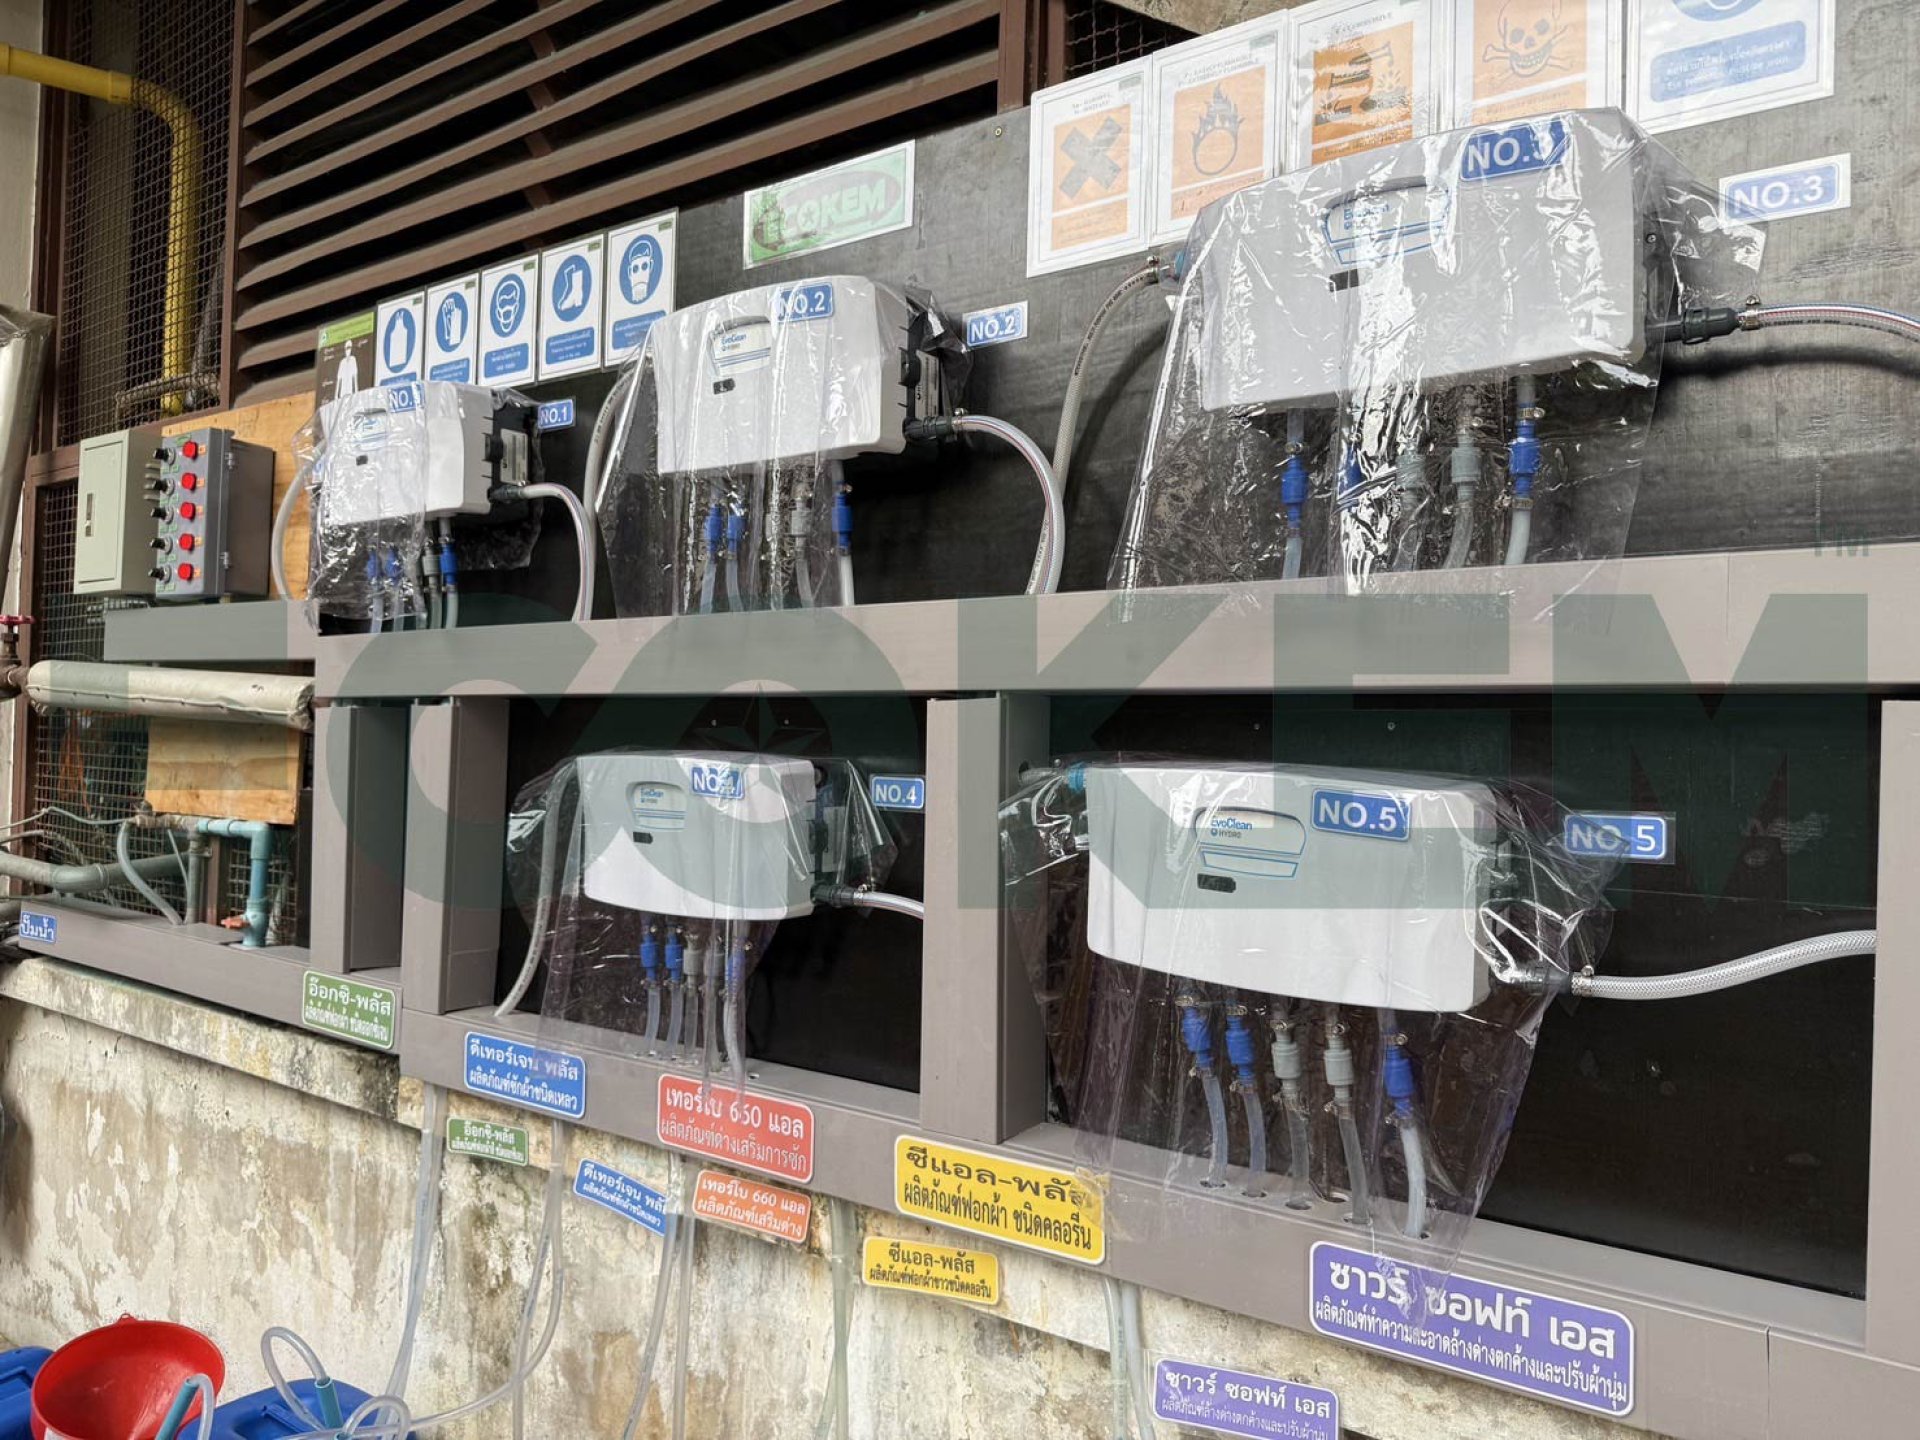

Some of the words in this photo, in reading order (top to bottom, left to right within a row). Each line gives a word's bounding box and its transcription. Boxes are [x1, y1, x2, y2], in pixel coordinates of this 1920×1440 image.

[1734, 174, 1823, 210] NO.3
[781, 290, 826, 317] NO.2
[970, 316, 1016, 344] NO.2
[389, 382, 421, 409] NO.
[540, 405, 568, 425] NO.1
[875, 784, 917, 804] NO.4
[1211, 817, 1253, 830] EvoClean
[1319, 800, 1398, 833] NO.5
[309, 976, 391, 1016] อ๊อกซิ-พลัส
[769, 1112, 805, 1139] แอล
[752, 1189, 777, 1207] 660
[781, 1198, 806, 1216] แอล
[904, 1174, 1008, 1230] ผลิตภัณฑ์ฟอกผ้า
[1013, 1200, 1091, 1250] ชนิดคลอรีน
[888, 1241, 976, 1275] ซีแอล-พลัส
[1549, 1315, 1616, 1361] เอส
[1295, 1394, 1331, 1419] เอส
